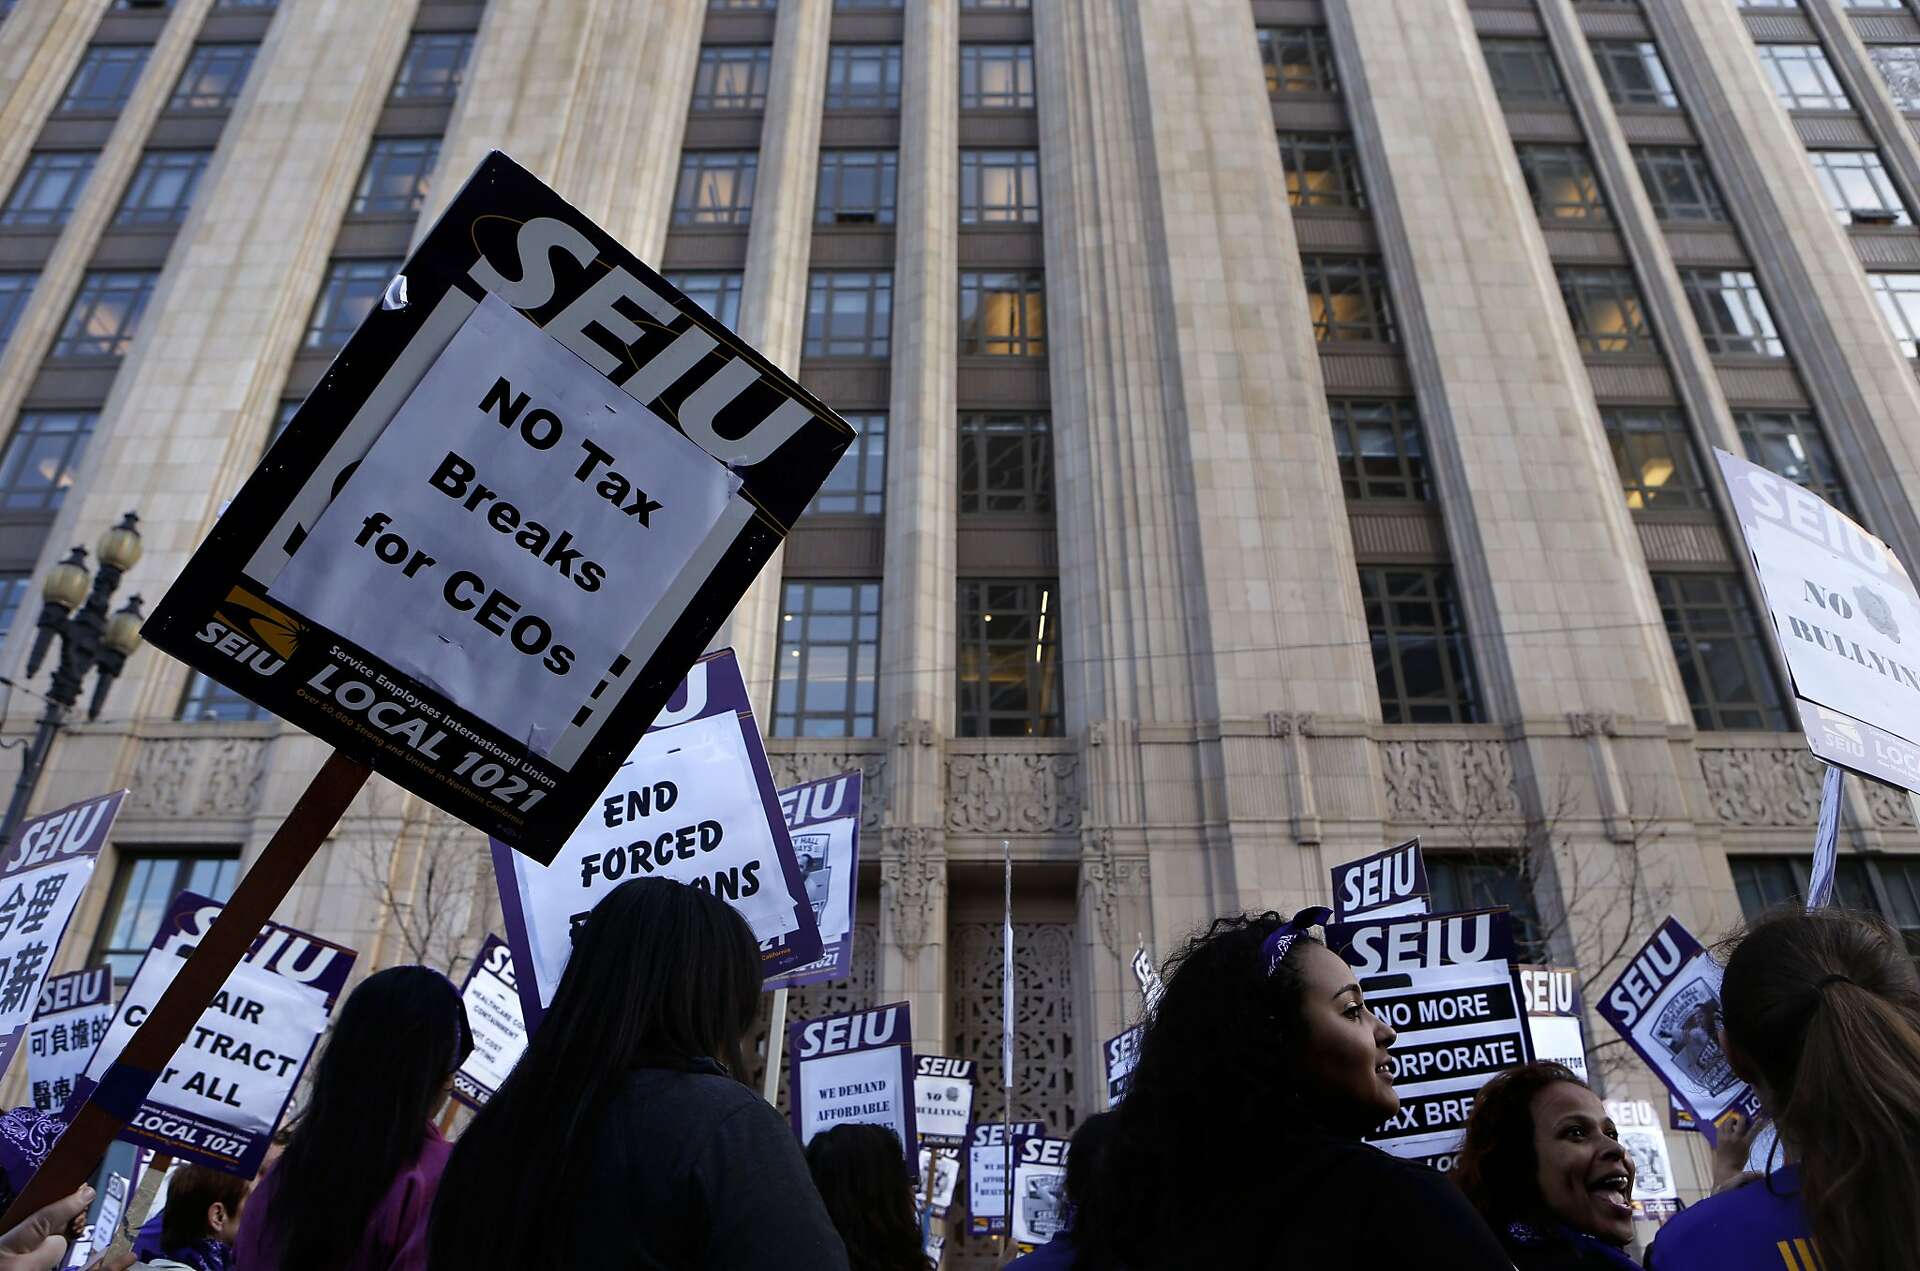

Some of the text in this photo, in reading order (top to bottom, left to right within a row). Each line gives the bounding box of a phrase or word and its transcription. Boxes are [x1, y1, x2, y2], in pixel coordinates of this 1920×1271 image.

[467, 217, 815, 467] SEIU
[478, 375, 664, 529] NO Tax
[428, 451, 606, 592] Breaks
[1748, 471, 1889, 574] SEIU
[354, 512, 576, 676] for CEOs
[1804, 579, 1853, 619] NO
[195, 621, 286, 676] SEIU
[1789, 615, 1920, 692] BULLYIN
[307, 664, 547, 813] LOCAL 1021
[329, 645, 557, 789] Service Employees International Union
[297, 688, 320, 705] Over
[354, 722, 385, 747] Strong
[385, 742, 405, 758] and
[406, 751, 436, 776] United
[446, 776, 485, 804] Northern
[486, 799, 525, 826] California
[1874, 740, 1920, 774] LOC
[604, 781, 678, 828] END
[779, 777, 848, 827] EIU
[5, 799, 111, 873] SEIU
[581, 820, 723, 888] FORCED
[1343, 846, 1416, 912] SEIU
[164, 906, 338, 983] SIU
[1350, 913, 1490, 975] SEIU
[39, 969, 104, 1013] SEIU
[1520, 970, 1572, 1012] SEIU
[1610, 929, 1682, 1027] SEIU
[208, 990, 265, 1025] AIR
[1372, 993, 1490, 1026] NO MORE
[31, 1014, 111, 1058] 可負擔的
[124, 1004, 297, 1077] CTRACT
[800, 1007, 897, 1058] SEIU
[917, 1057, 971, 1078] SEIU
[1389, 1040, 1518, 1080] ORPORATE
[182, 1071, 241, 1108] ALL
[454, 1077, 479, 1099] OCAL
[816, 1100, 890, 1121] AFFORDABLE
[819, 1080, 887, 1100] WE DEMAND
[926, 1091, 942, 1102] NO
[131, 1112, 198, 1143] LOCAL
[202, 1134, 248, 1157] 1021
[1376, 1097, 1475, 1132] AX BRE
[1608, 1101, 1652, 1126] SEIU
[1021, 1138, 1072, 1165] SEI
